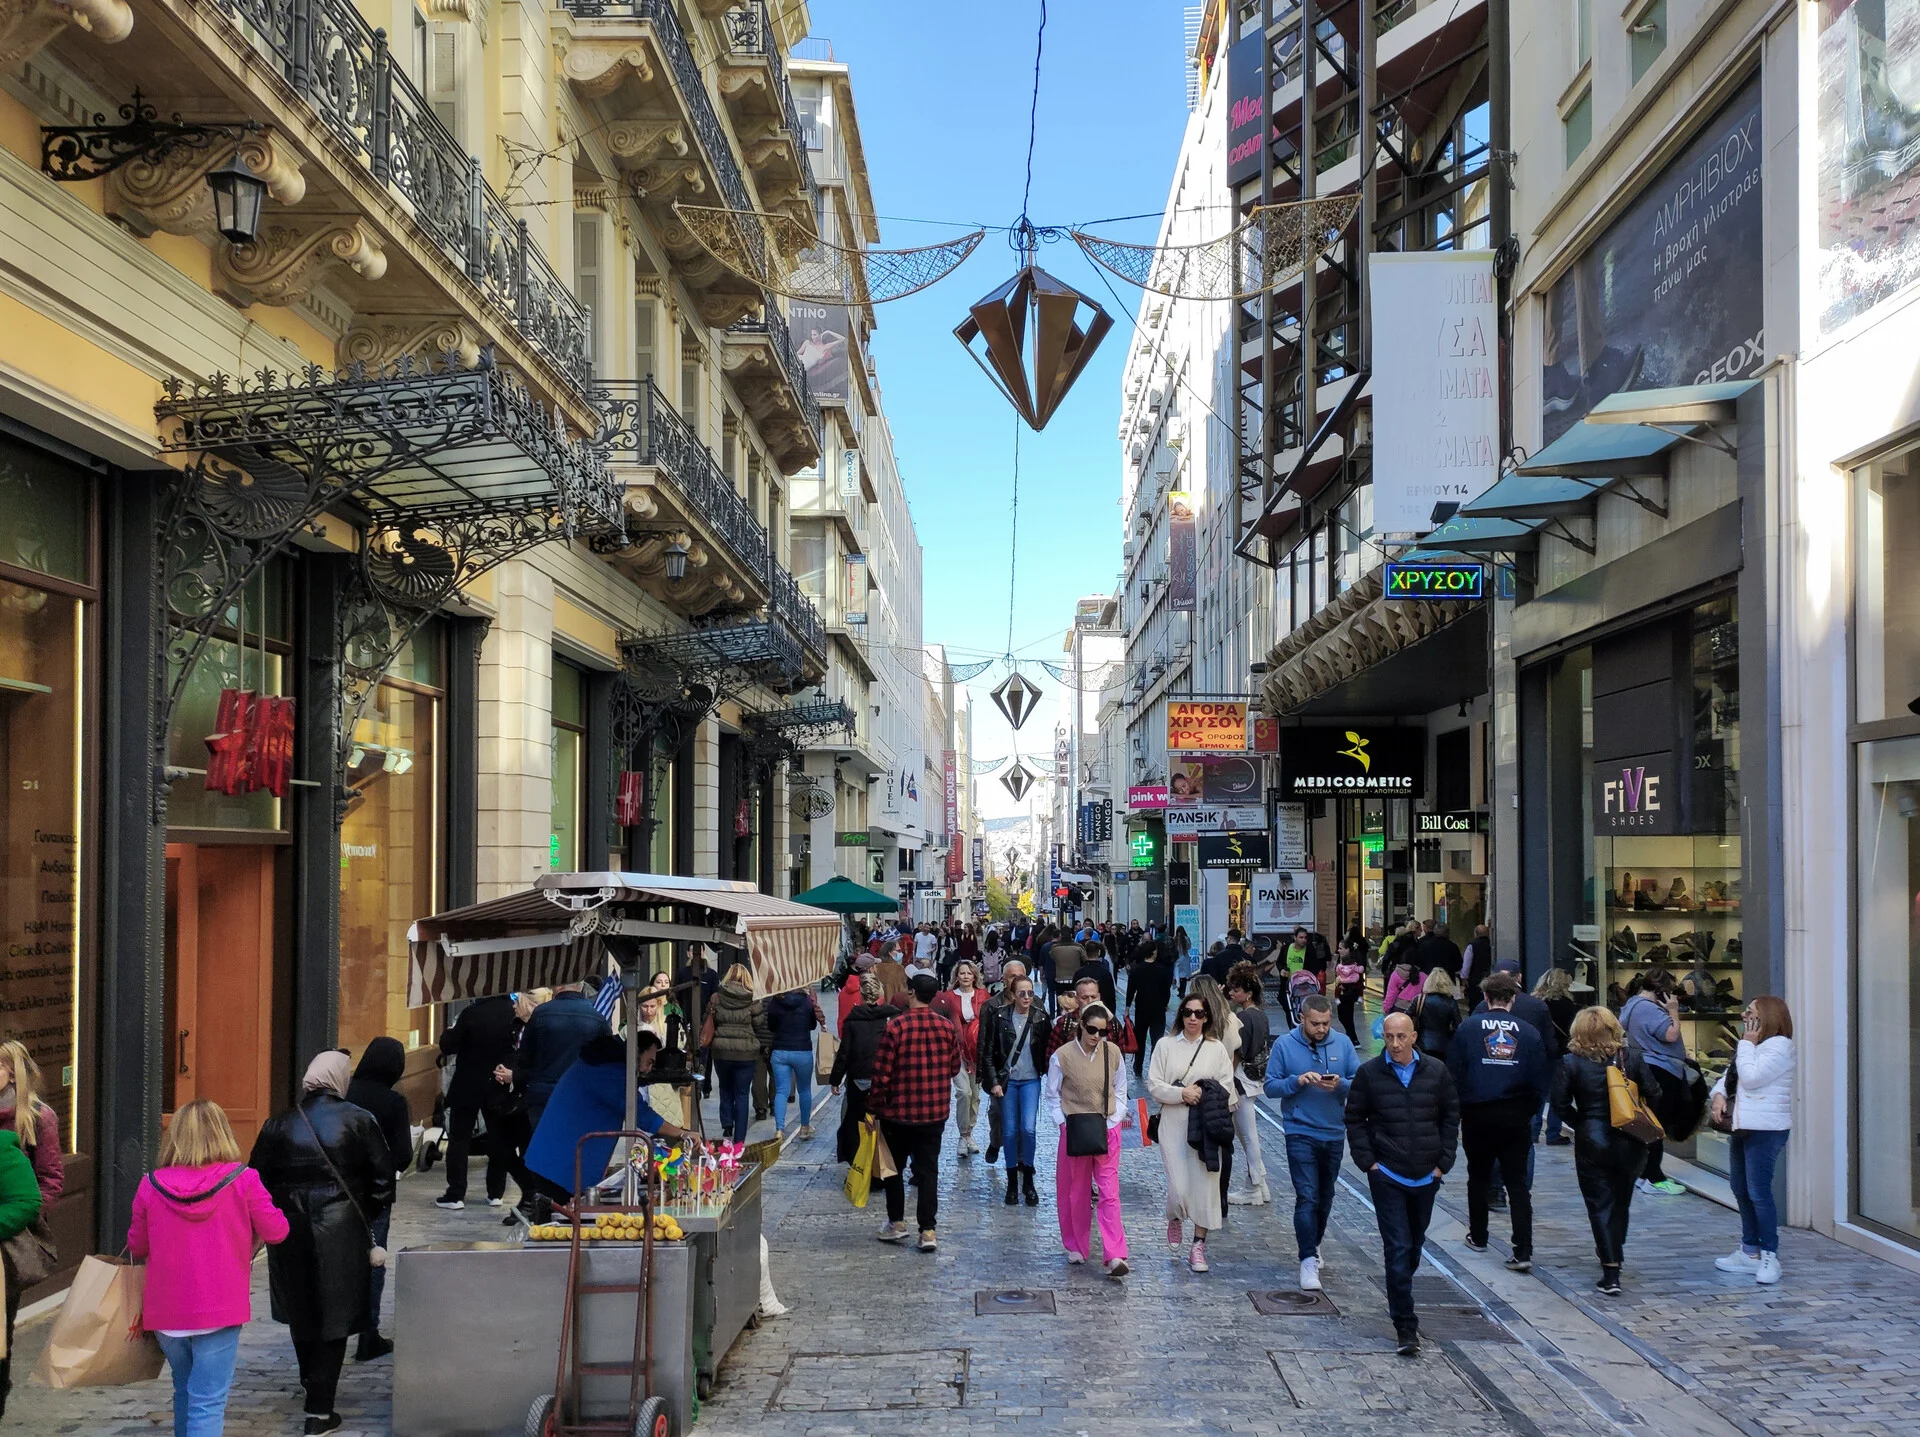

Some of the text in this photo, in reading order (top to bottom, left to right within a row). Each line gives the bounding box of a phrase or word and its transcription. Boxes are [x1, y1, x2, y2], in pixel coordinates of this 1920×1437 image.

[1653, 114, 1756, 246] AMPHIBIOX
[1665, 219, 1699, 265] βροχή
[1653, 244, 1708, 303] πάνω μας
[1693, 328, 1764, 386] GEOX
[1454, 484, 1468, 495] 14
[1186, 531, 1195, 588] MASSAGE
[1390, 571, 1480, 590] ΧΡΥΣΟΥ
[1176, 703, 1238, 715] ΑΓΟΡΑ
[1169, 716, 1245, 728] ΧΡΥΣΟΥ
[1169, 729, 1245, 748] 1ος ΟΡΟΦΟΣ
[886, 769, 895, 808] HOTEL
[946, 770, 955, 803] HOUSE
[1293, 776, 1412, 787] MEDICOSMETIC
[1131, 791, 1154, 803] pink
[947, 806, 956, 835] LAPIN
[1104, 800, 1112, 839] MANGO
[1421, 815, 1470, 830] Bill Cost
[1611, 815, 1654, 826] SHOES
[1481, 1019, 1520, 1032] NASA
